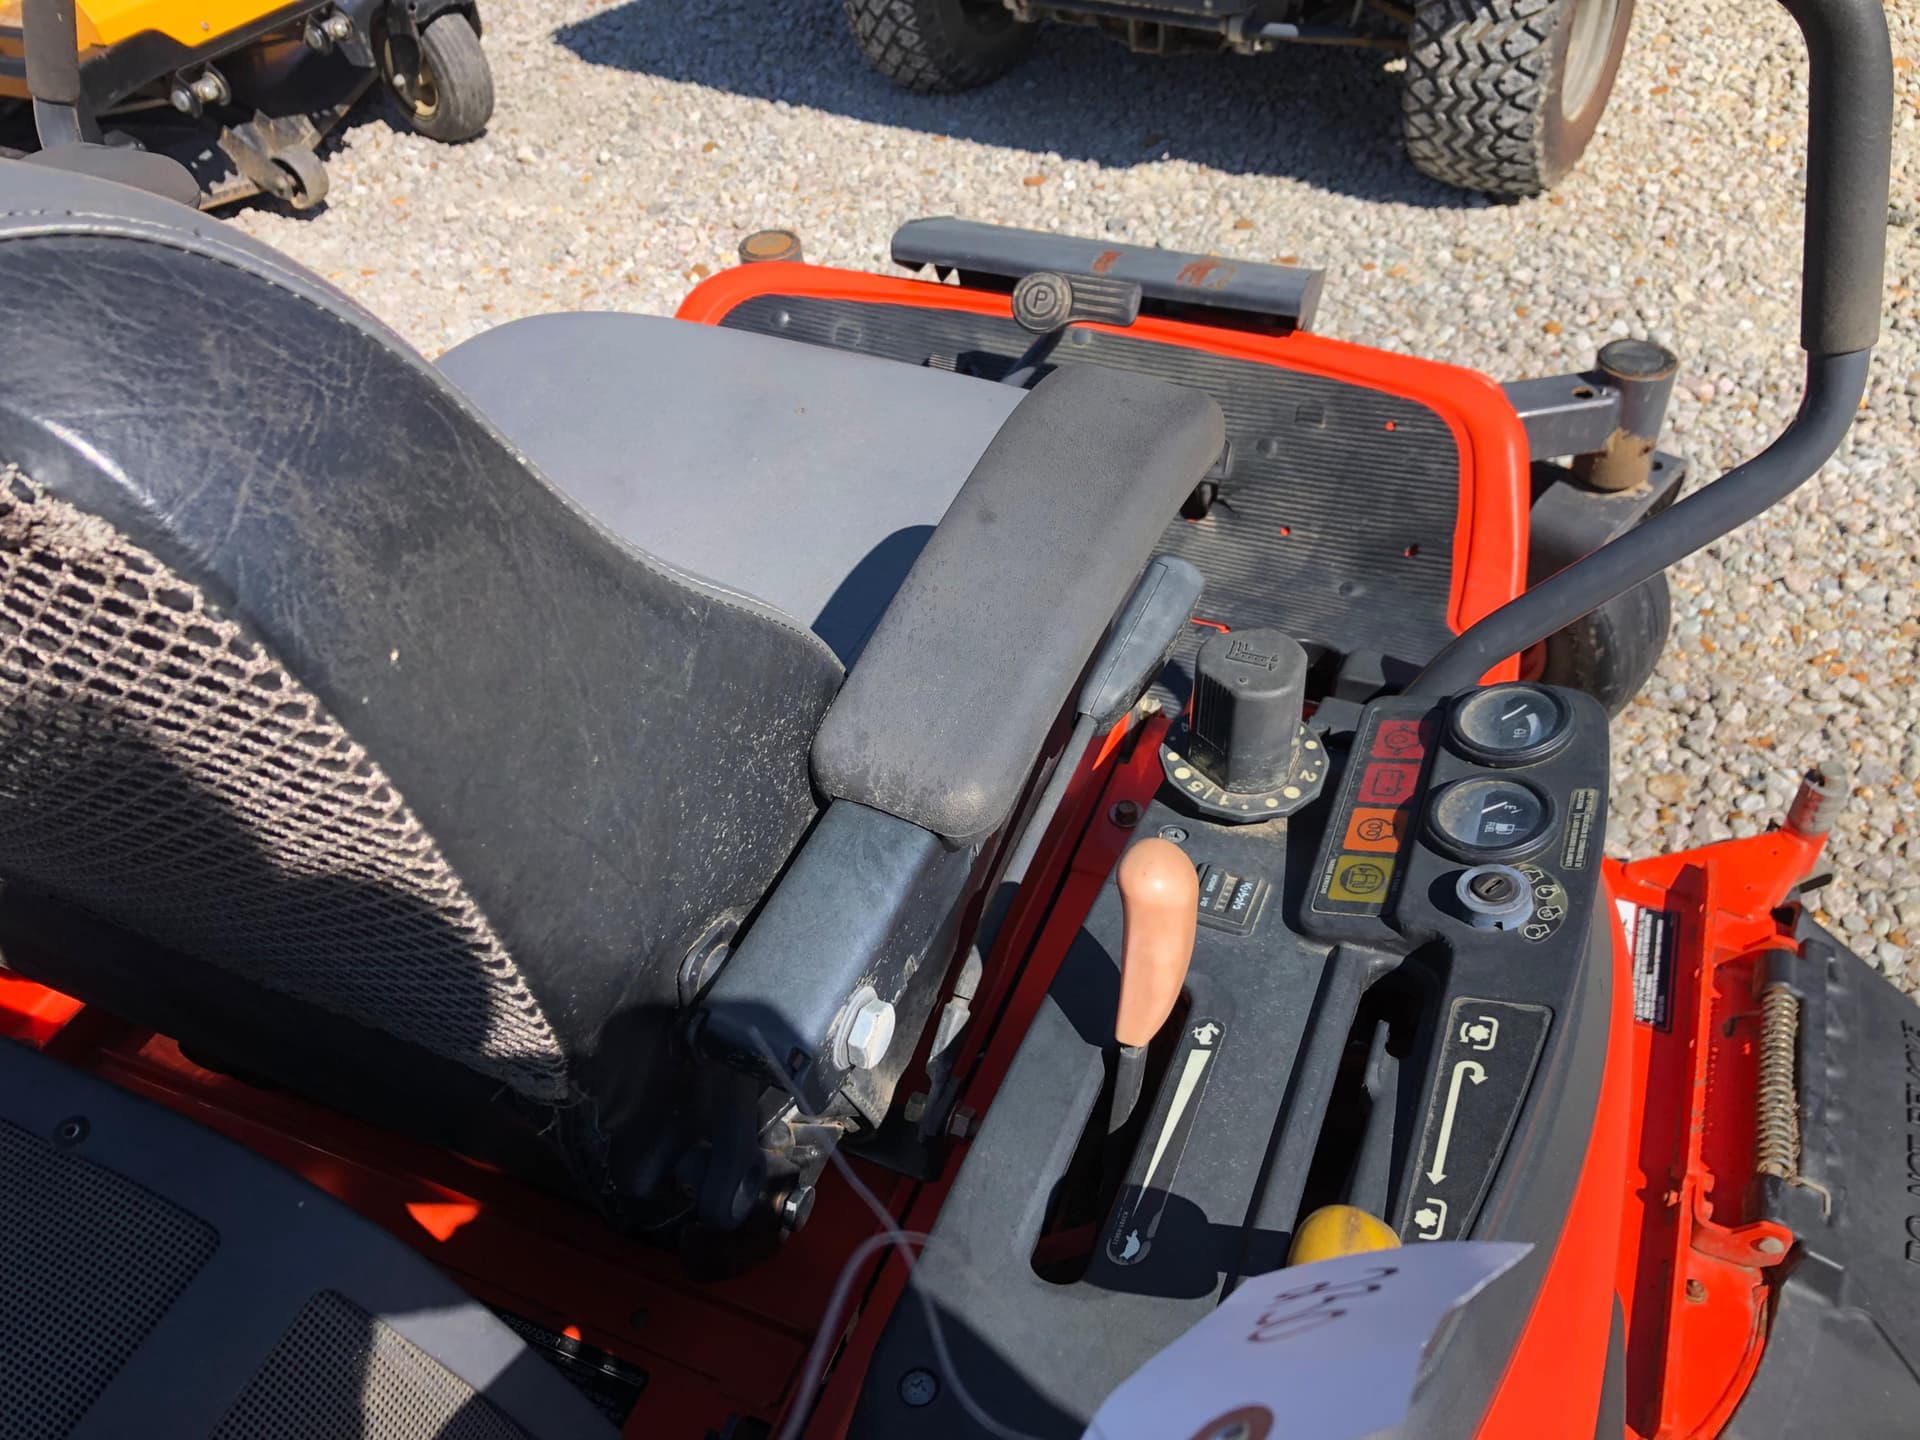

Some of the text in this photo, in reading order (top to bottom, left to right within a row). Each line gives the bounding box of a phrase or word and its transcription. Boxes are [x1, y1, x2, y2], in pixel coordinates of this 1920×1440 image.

[1033, 288, 1048, 309] P
[1300, 769, 1317, 783] 2
[1187, 780, 1204, 793] 5
[1484, 821, 1496, 833] FUEL
[1232, 881, 1253, 910] Kubota
